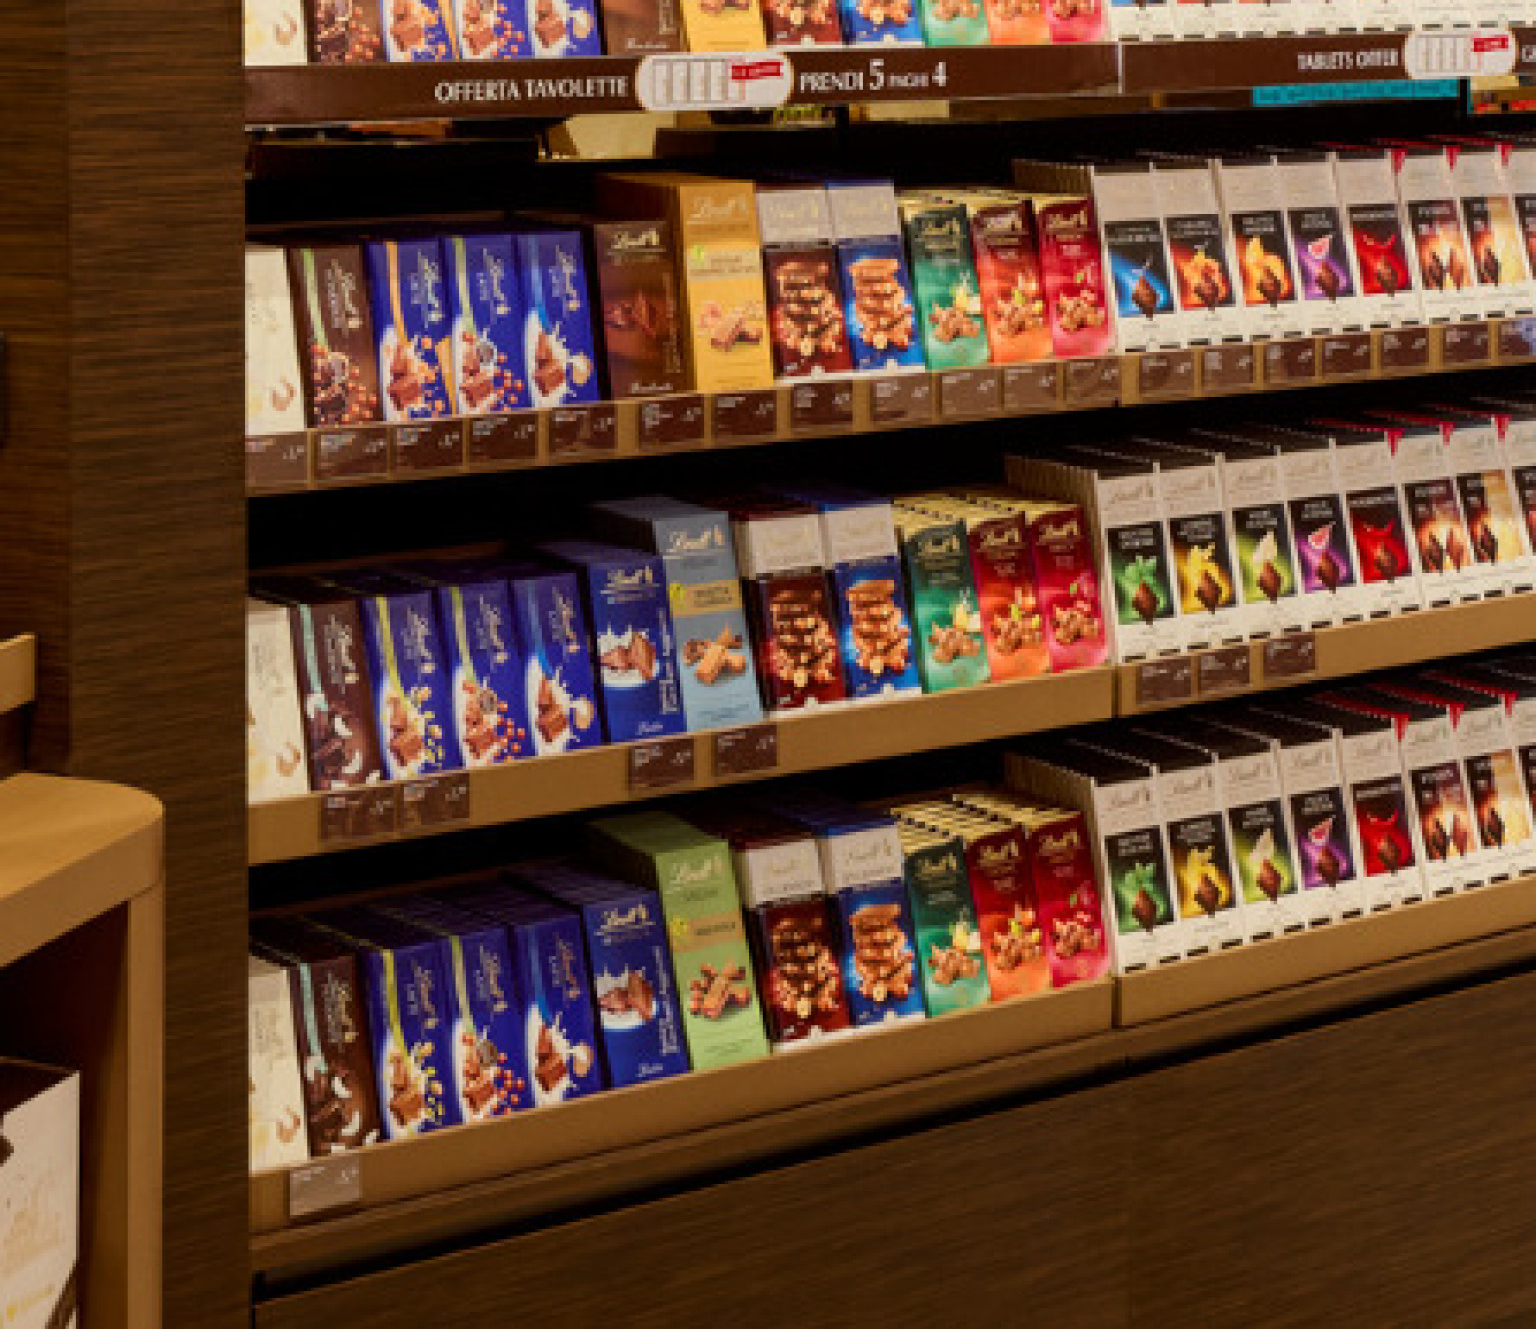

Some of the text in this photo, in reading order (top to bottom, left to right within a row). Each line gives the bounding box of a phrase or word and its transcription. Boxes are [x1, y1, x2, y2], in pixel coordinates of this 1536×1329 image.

[1297, 48, 1399, 71] TABLETS OFFER
[799, 69, 864, 94] PRENDI
[869, 59, 885, 90] 5
[932, 61, 948, 87] 4
[435, 75, 629, 104] OFFERTA TAVOLETTE
[611, 229, 654, 250] Lindt
[668, 530, 714, 553] Lindt
[606, 566, 646, 586] Lindt
[603, 905, 643, 927] Lindt
